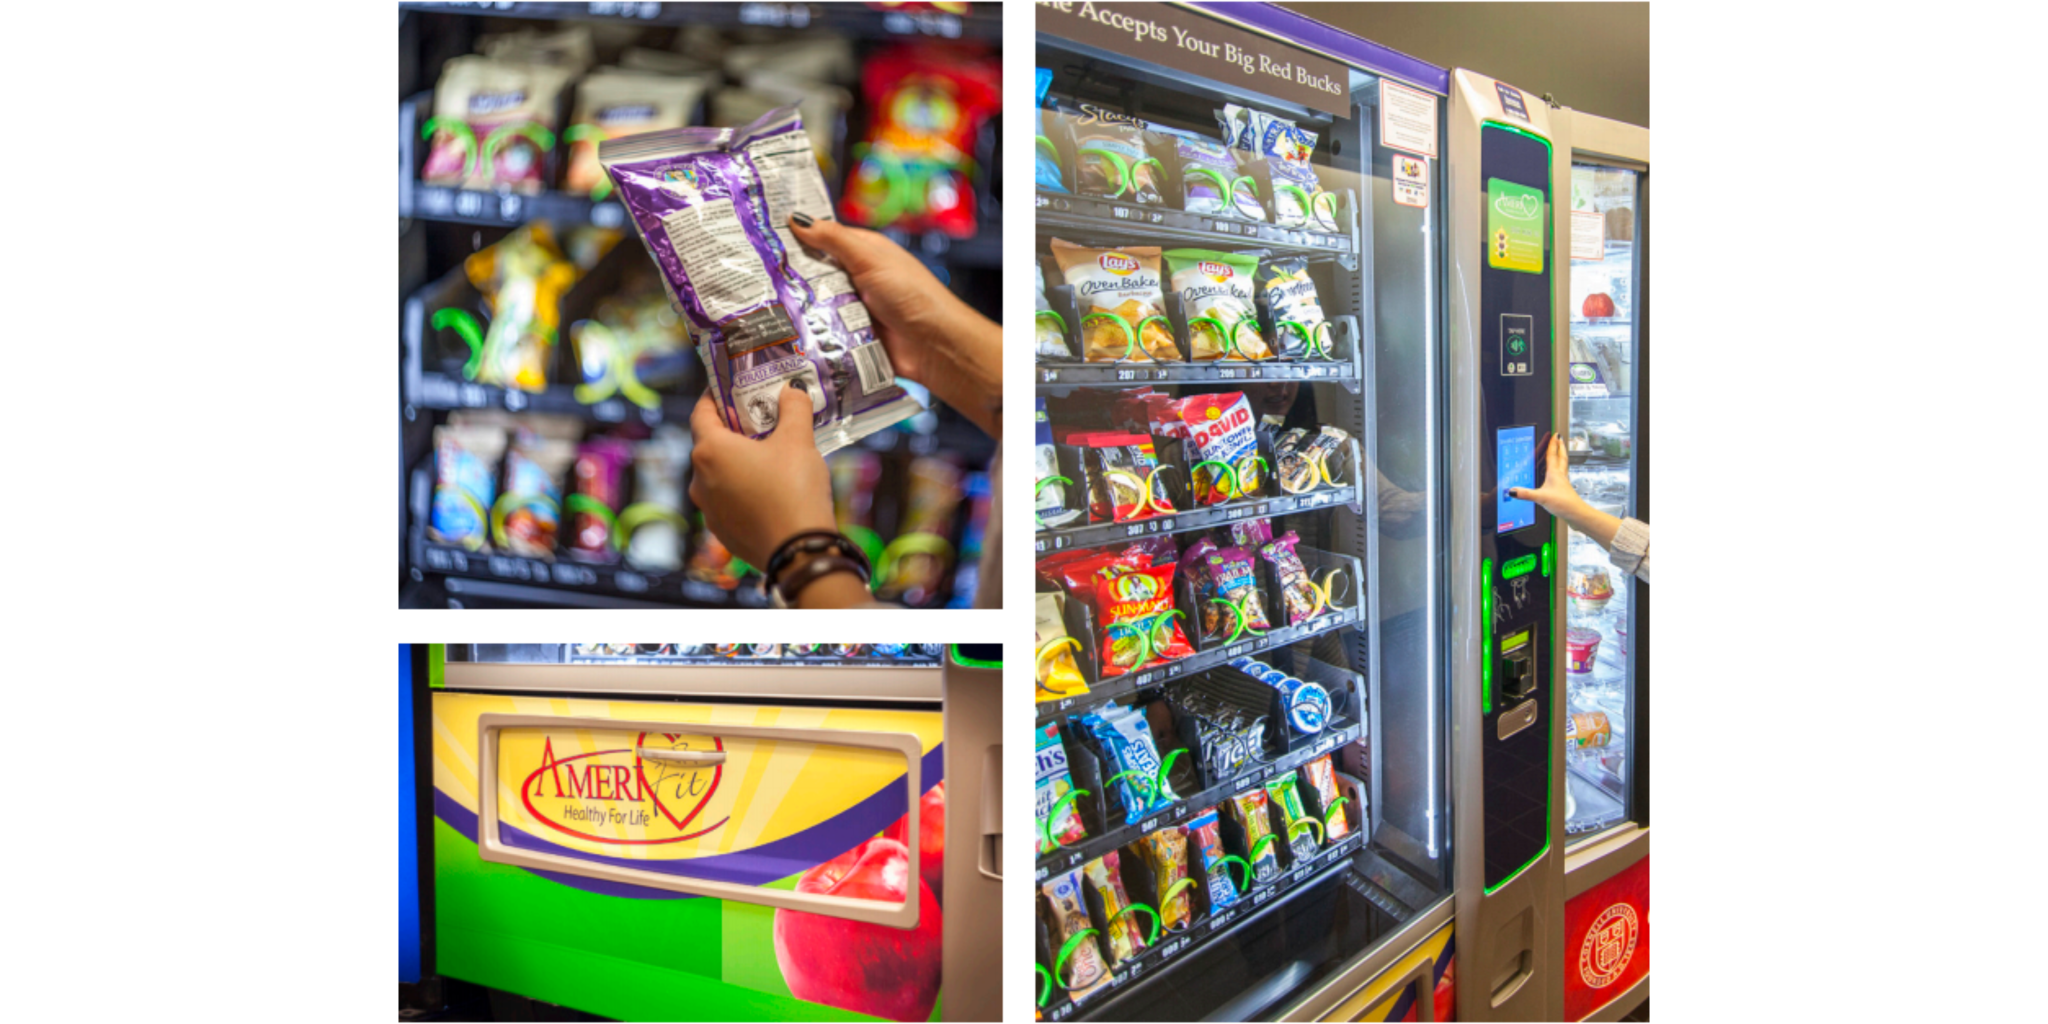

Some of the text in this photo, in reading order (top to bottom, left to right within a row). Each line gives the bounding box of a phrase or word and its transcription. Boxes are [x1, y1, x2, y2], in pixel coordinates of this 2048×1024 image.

[1078, 0, 1168, 42] Accepts
[1171, 26, 1221, 58] Your
[1224, 42, 1255, 74] Big
[1259, 54, 1292, 80] Red
[1296, 65, 1342, 96] Bucks
[1080, 280, 1118, 297] Oven
[1184, 284, 1218, 301] Oven
[1118, 370, 1135, 380] 207
[1193, 407, 1250, 449] DAVID
[1127, 524, 1145, 535] 307
[563, 804, 650, 827] Healthy For Life
